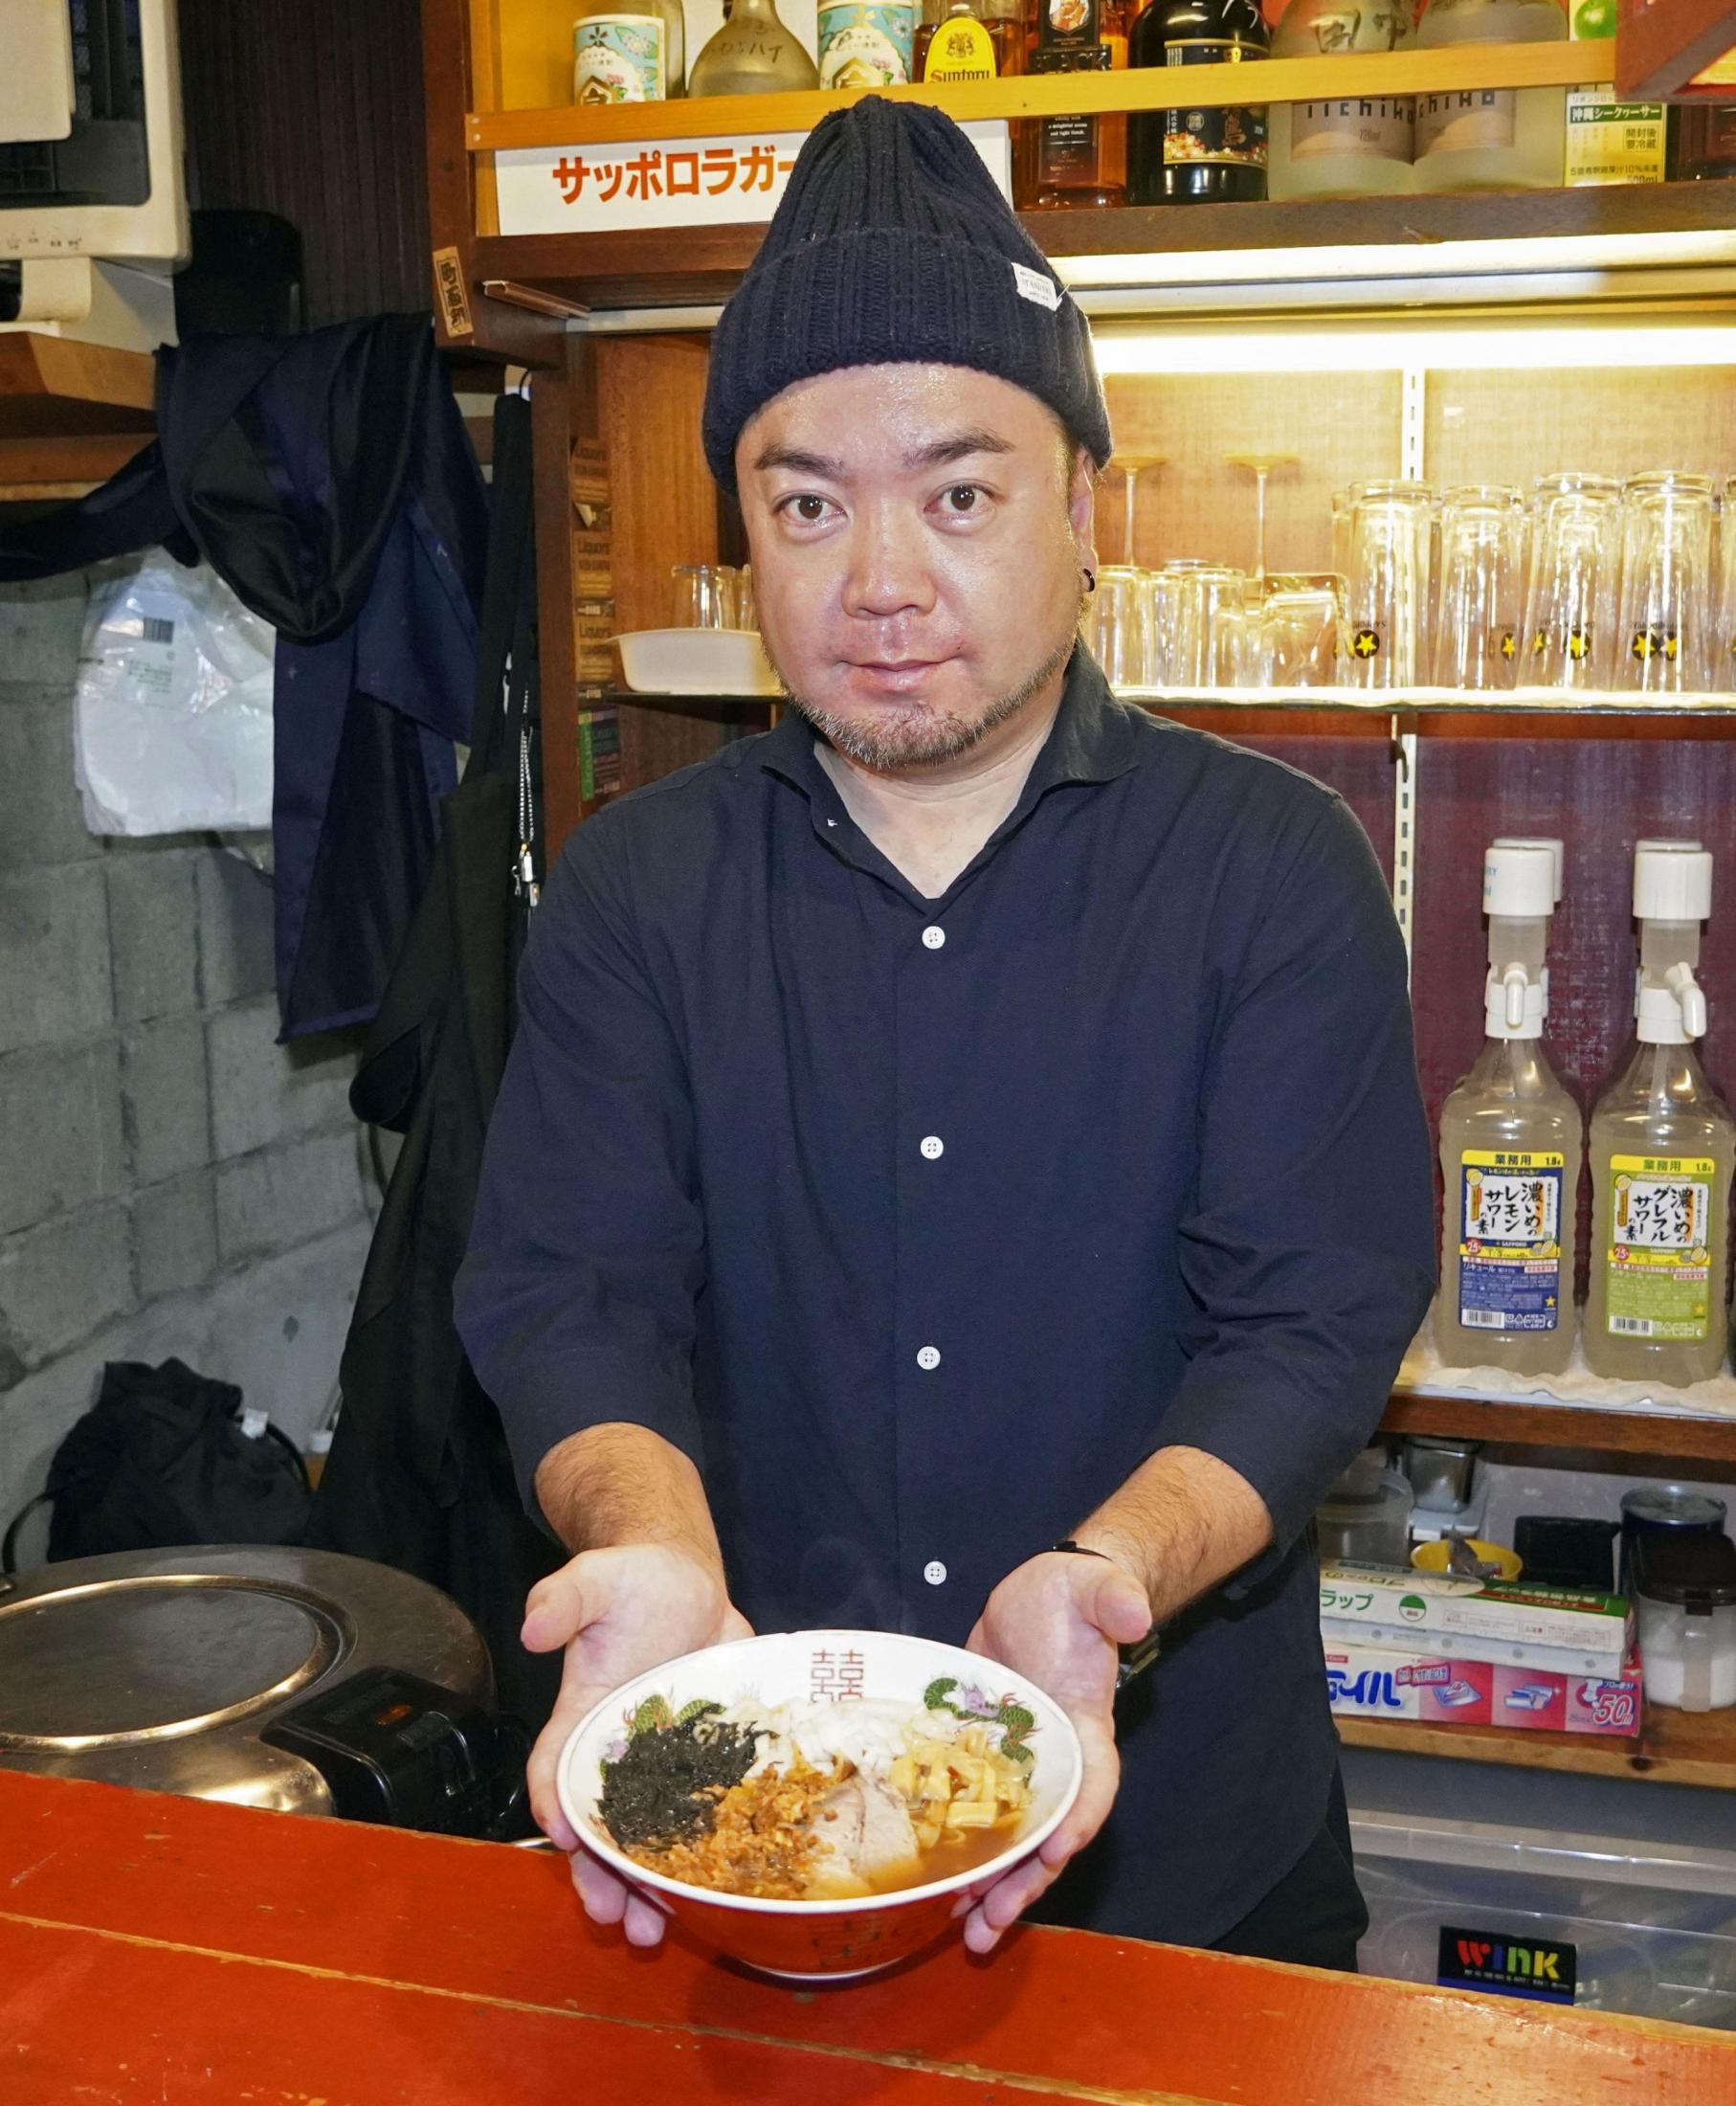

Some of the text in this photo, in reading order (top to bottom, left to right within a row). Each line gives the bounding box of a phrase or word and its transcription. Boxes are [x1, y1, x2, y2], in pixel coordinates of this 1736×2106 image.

[1419, 91, 1495, 117] chiko
[552, 145, 795, 205] サッポロラガー
[1495, 1154, 1531, 1165] 業務用
[1643, 1159, 1681, 1172] 業務用
[1321, 1588, 1374, 1611] ラップ
